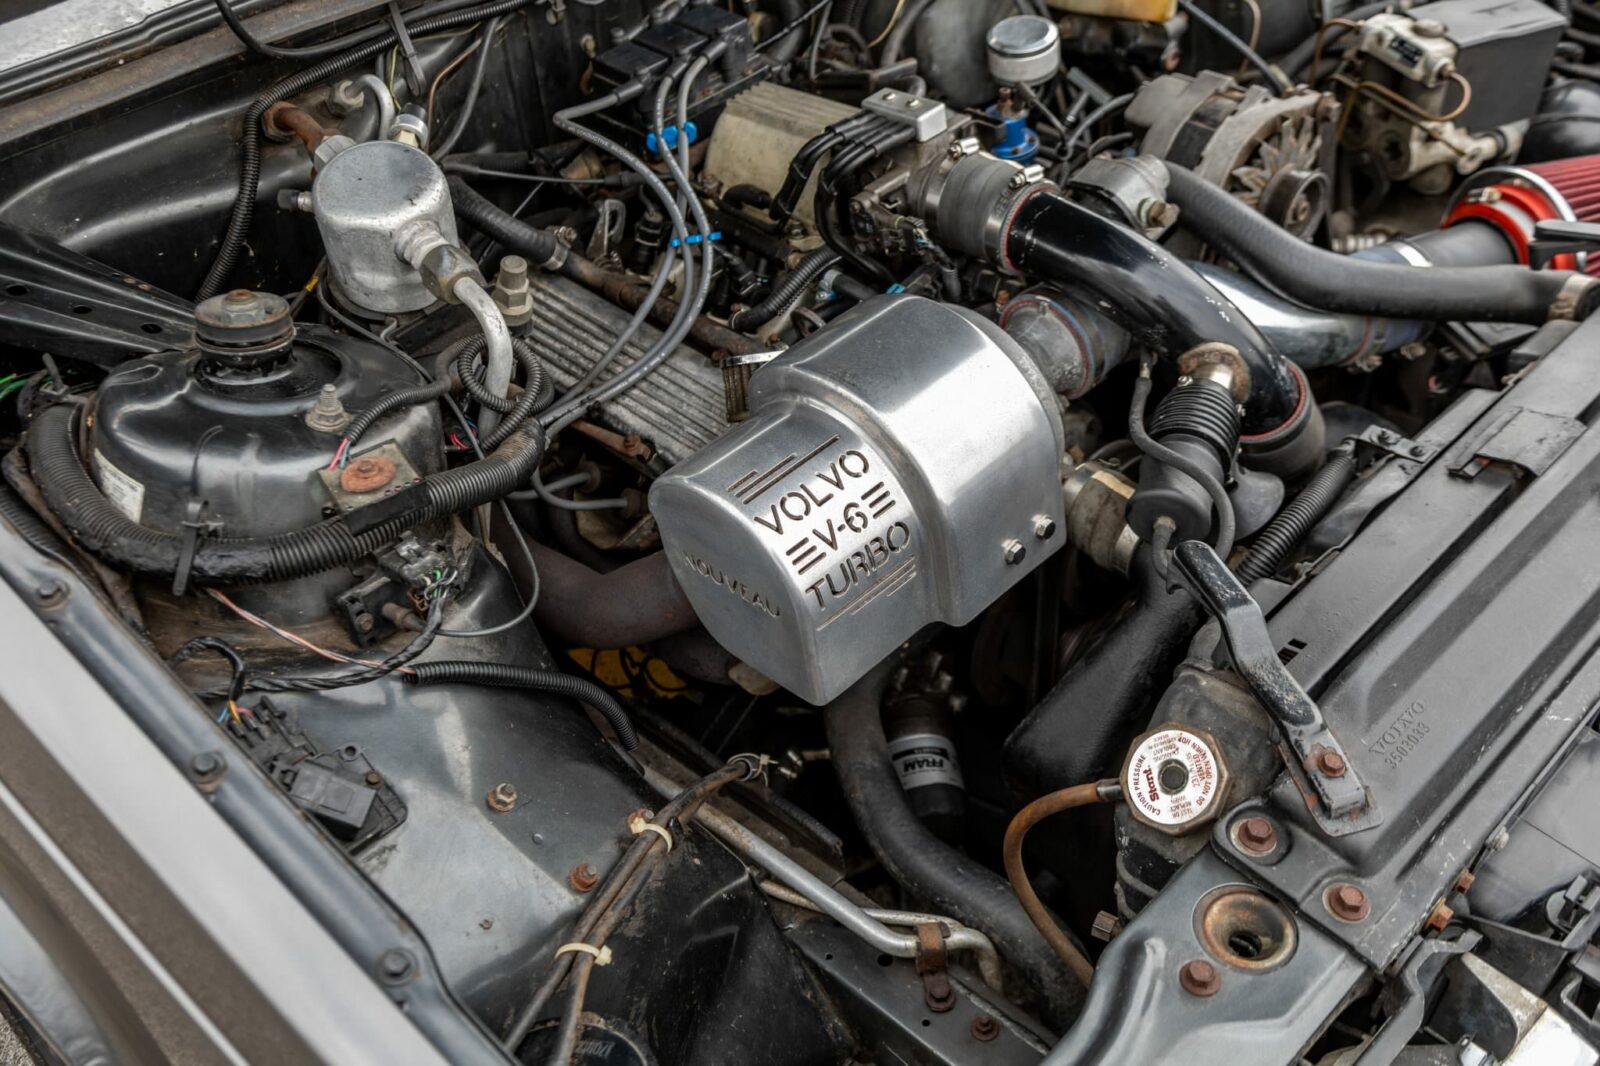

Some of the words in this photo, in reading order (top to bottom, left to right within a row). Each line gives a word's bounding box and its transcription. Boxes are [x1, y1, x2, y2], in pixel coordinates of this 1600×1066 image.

[754, 450, 869, 535] VOLVO
[812, 502, 868, 550] V-6
[805, 521, 910, 611] TURBO
[683, 552, 780, 618] NOUVEAU
[1368, 702, 1424, 755] VOLVO
[904, 758, 944, 772] FRAM
[1133, 755, 1146, 791] PRESSURE
[1193, 754, 1205, 781] VENTED
[1203, 760, 1213, 780] OPEN
[1143, 767, 1159, 802] Stant
[1202, 781, 1212, 796] NOT
[1137, 792, 1161, 816] CAUTION
